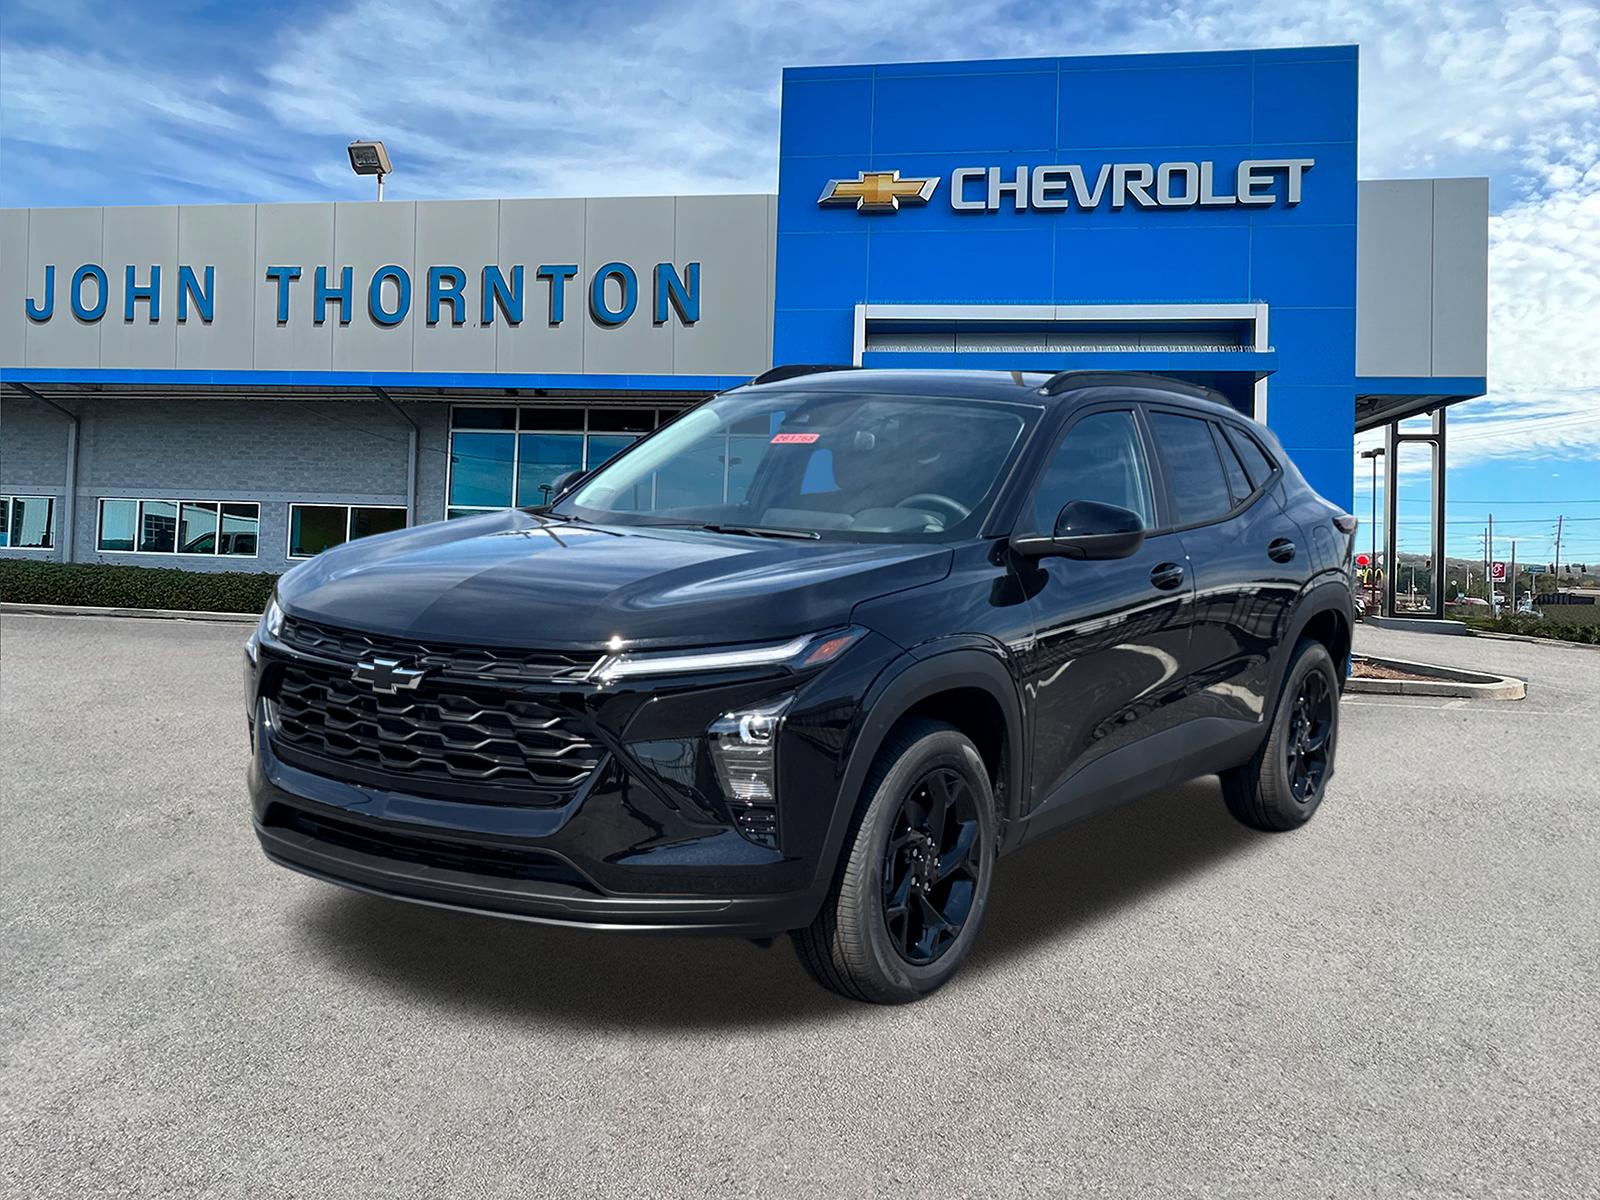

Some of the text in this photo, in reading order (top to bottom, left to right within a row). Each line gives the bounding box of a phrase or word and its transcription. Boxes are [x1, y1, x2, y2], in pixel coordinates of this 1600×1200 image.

[951, 158, 1315, 213] CHEVROLET
[25, 261, 702, 328] JOHN THORNTON
